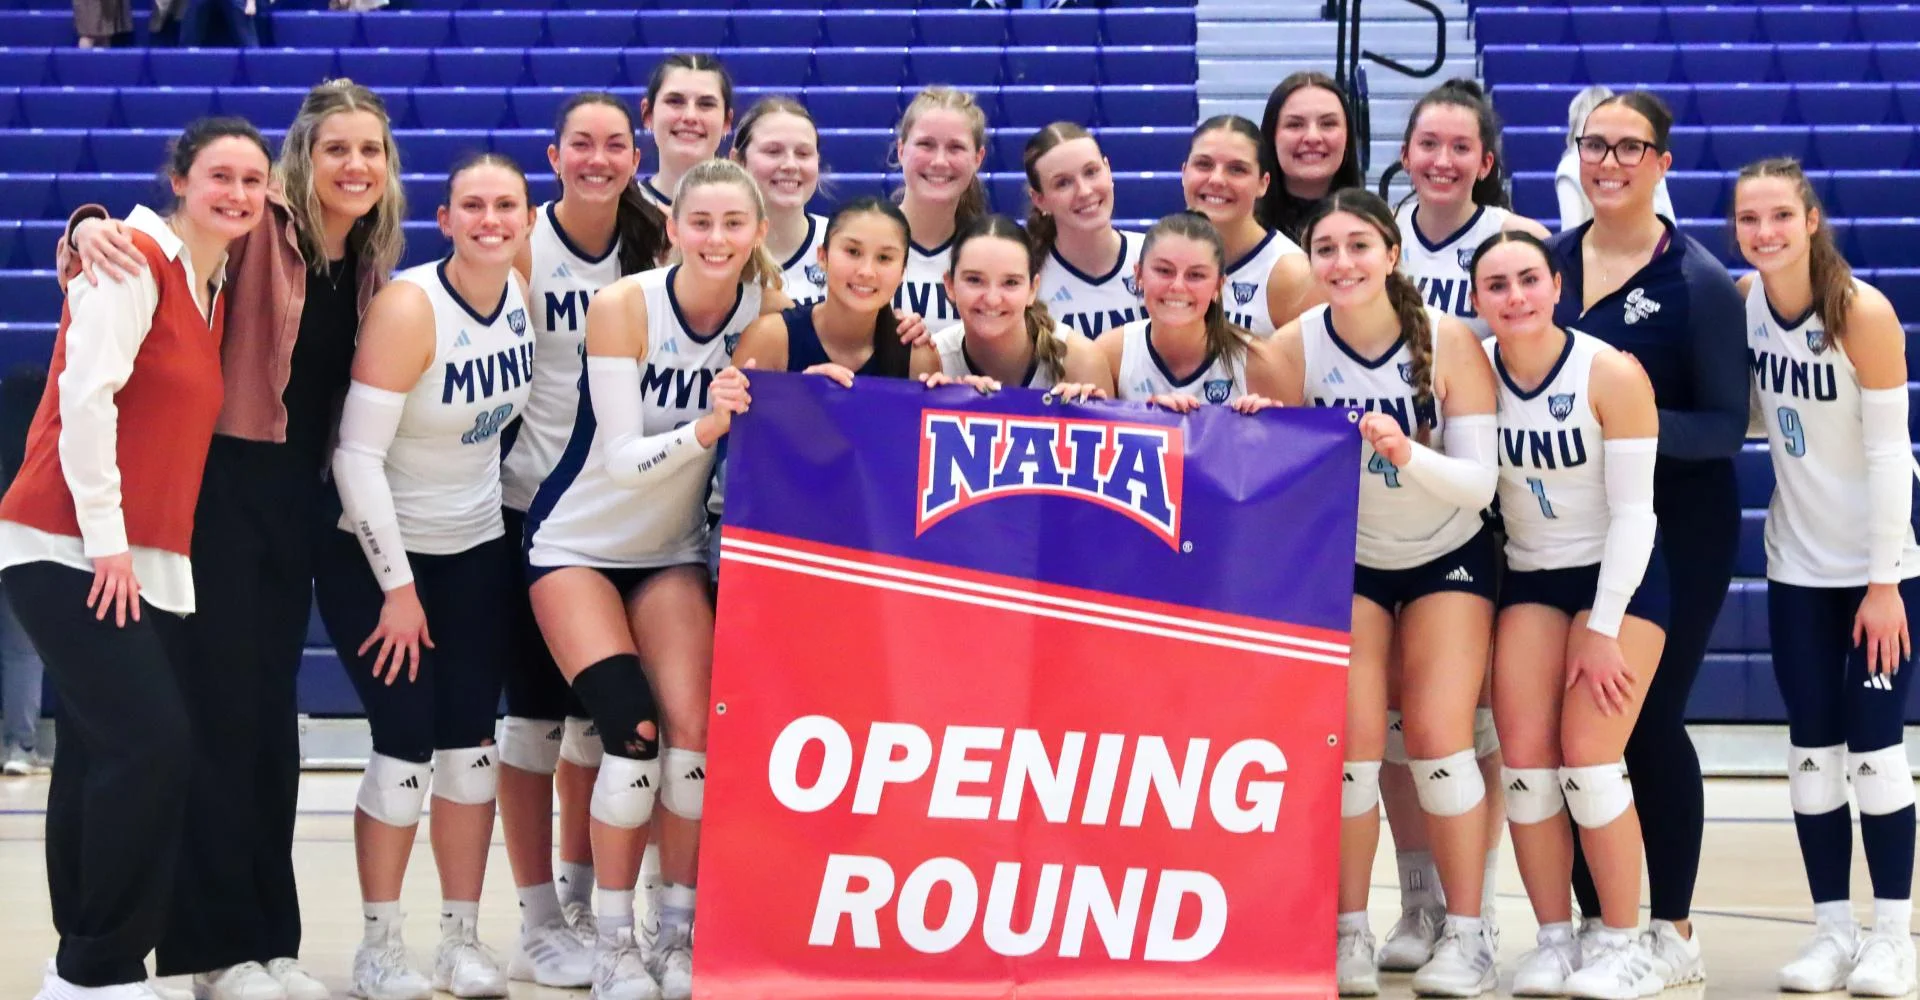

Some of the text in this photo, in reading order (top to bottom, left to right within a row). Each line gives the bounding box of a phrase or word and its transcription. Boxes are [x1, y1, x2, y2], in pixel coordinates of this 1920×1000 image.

[442, 341, 534, 405] MVNU
[1747, 347, 1838, 402] MVNU
[1777, 406, 1806, 458] 9
[637, 450, 668, 474] FOR HIM
[921, 414, 1176, 537] NAIA
[1367, 450, 1402, 489] 4
[1526, 477, 1559, 519] 1
[768, 714, 1289, 833] OPENING
[807, 853, 1228, 963] ROUND
